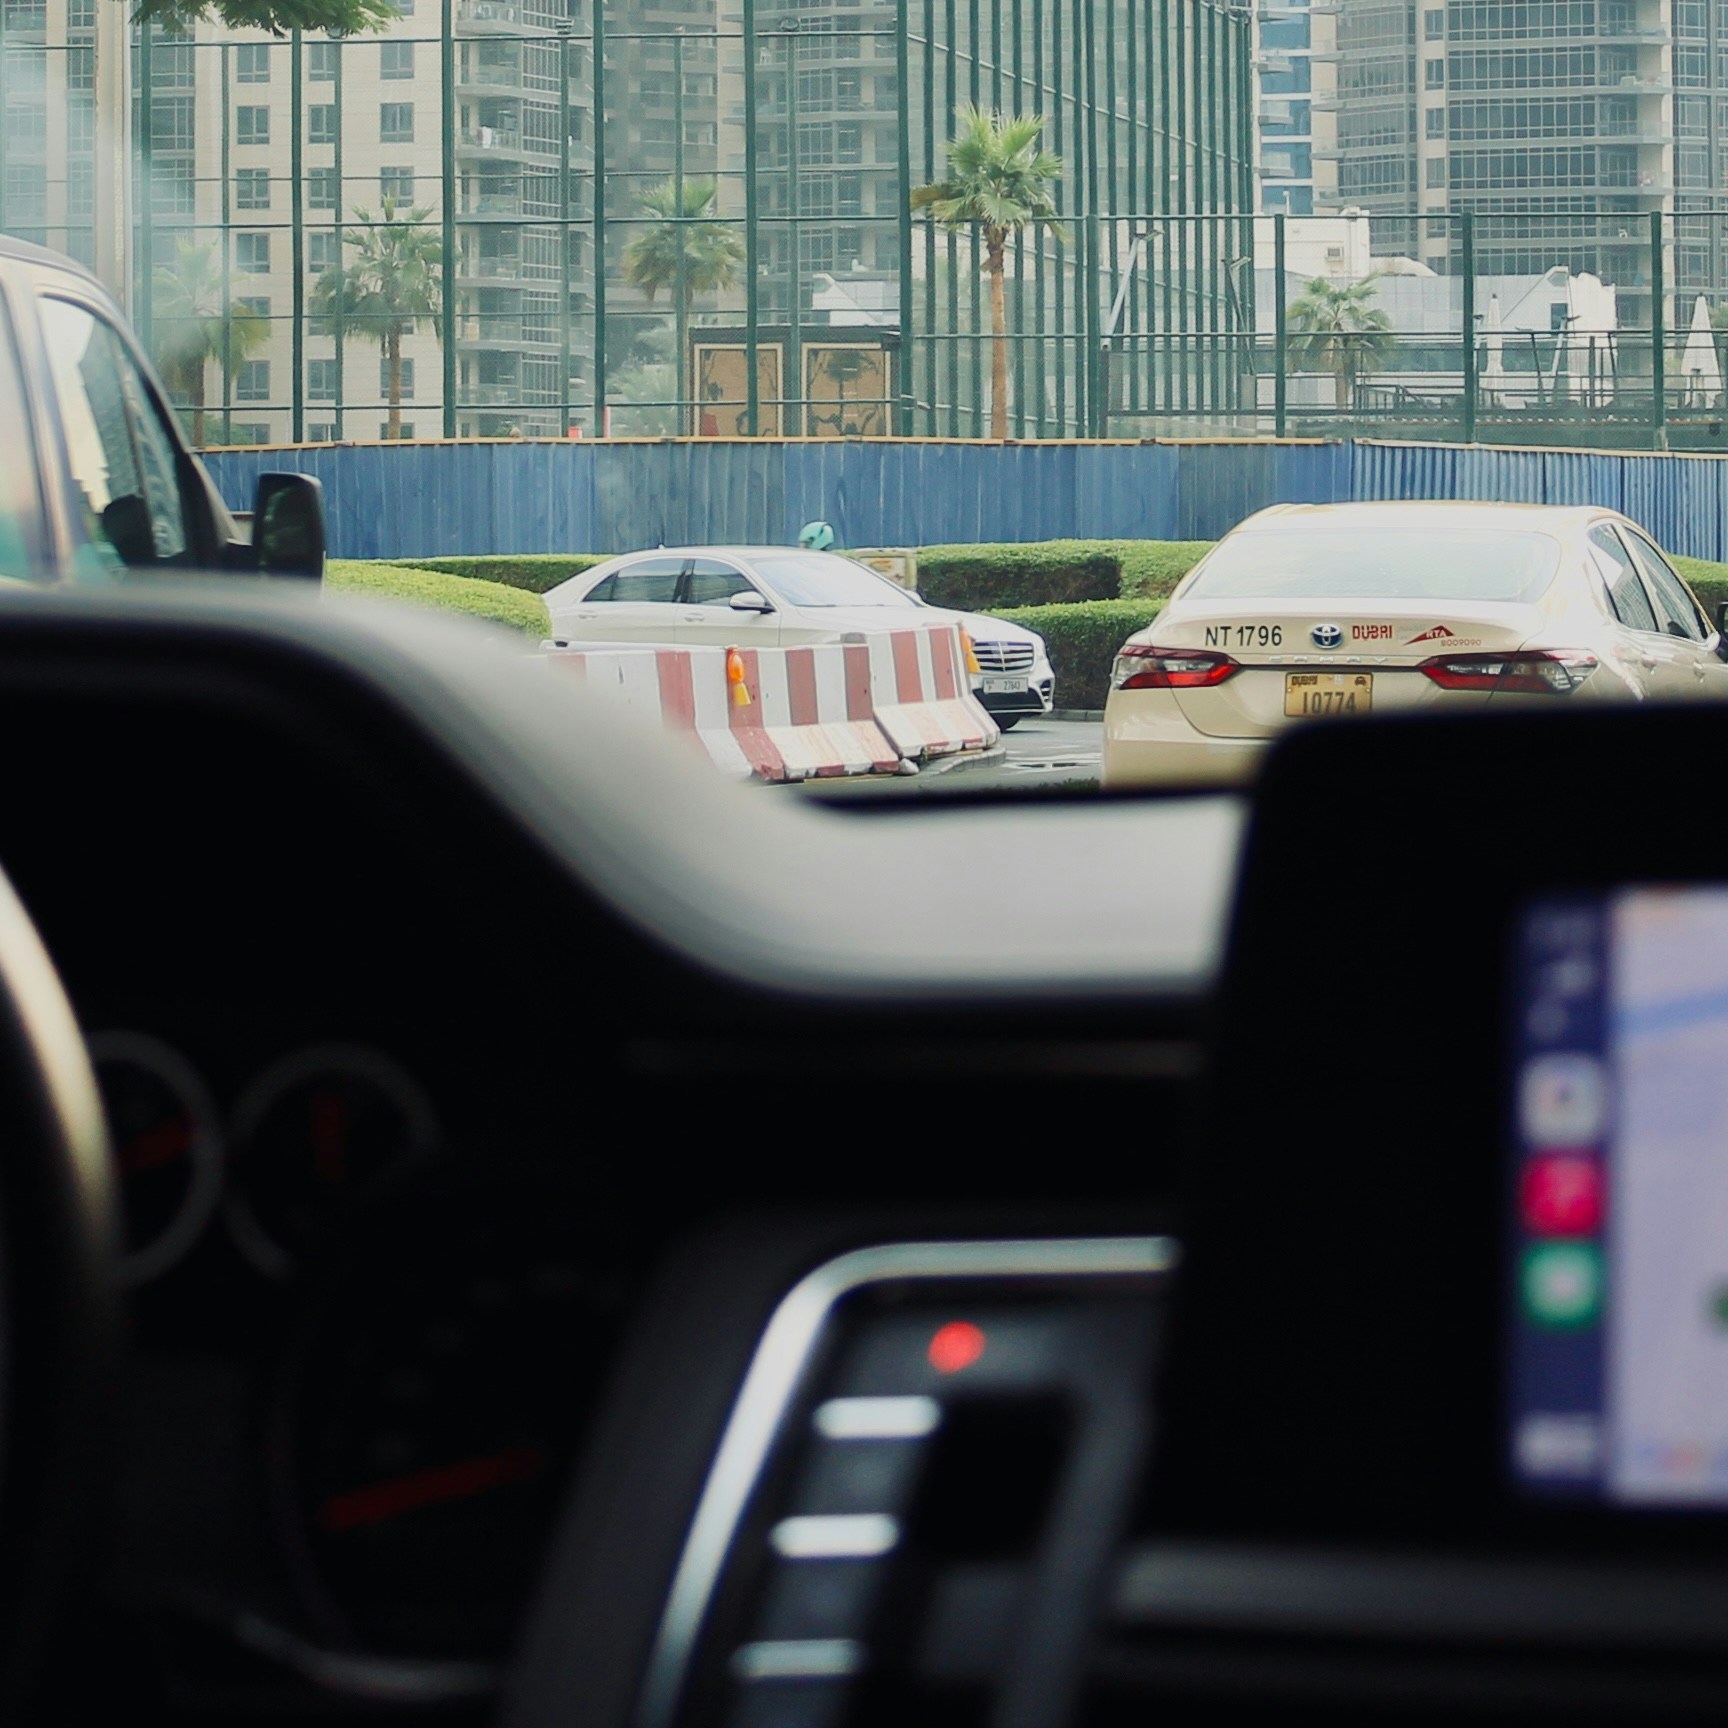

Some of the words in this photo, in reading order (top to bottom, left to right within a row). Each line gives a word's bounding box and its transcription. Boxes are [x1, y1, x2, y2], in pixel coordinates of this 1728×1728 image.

[1205, 626, 1231, 646] NT
[1237, 625, 1283, 647] 1796
[1302, 691, 1357, 714] 10774
